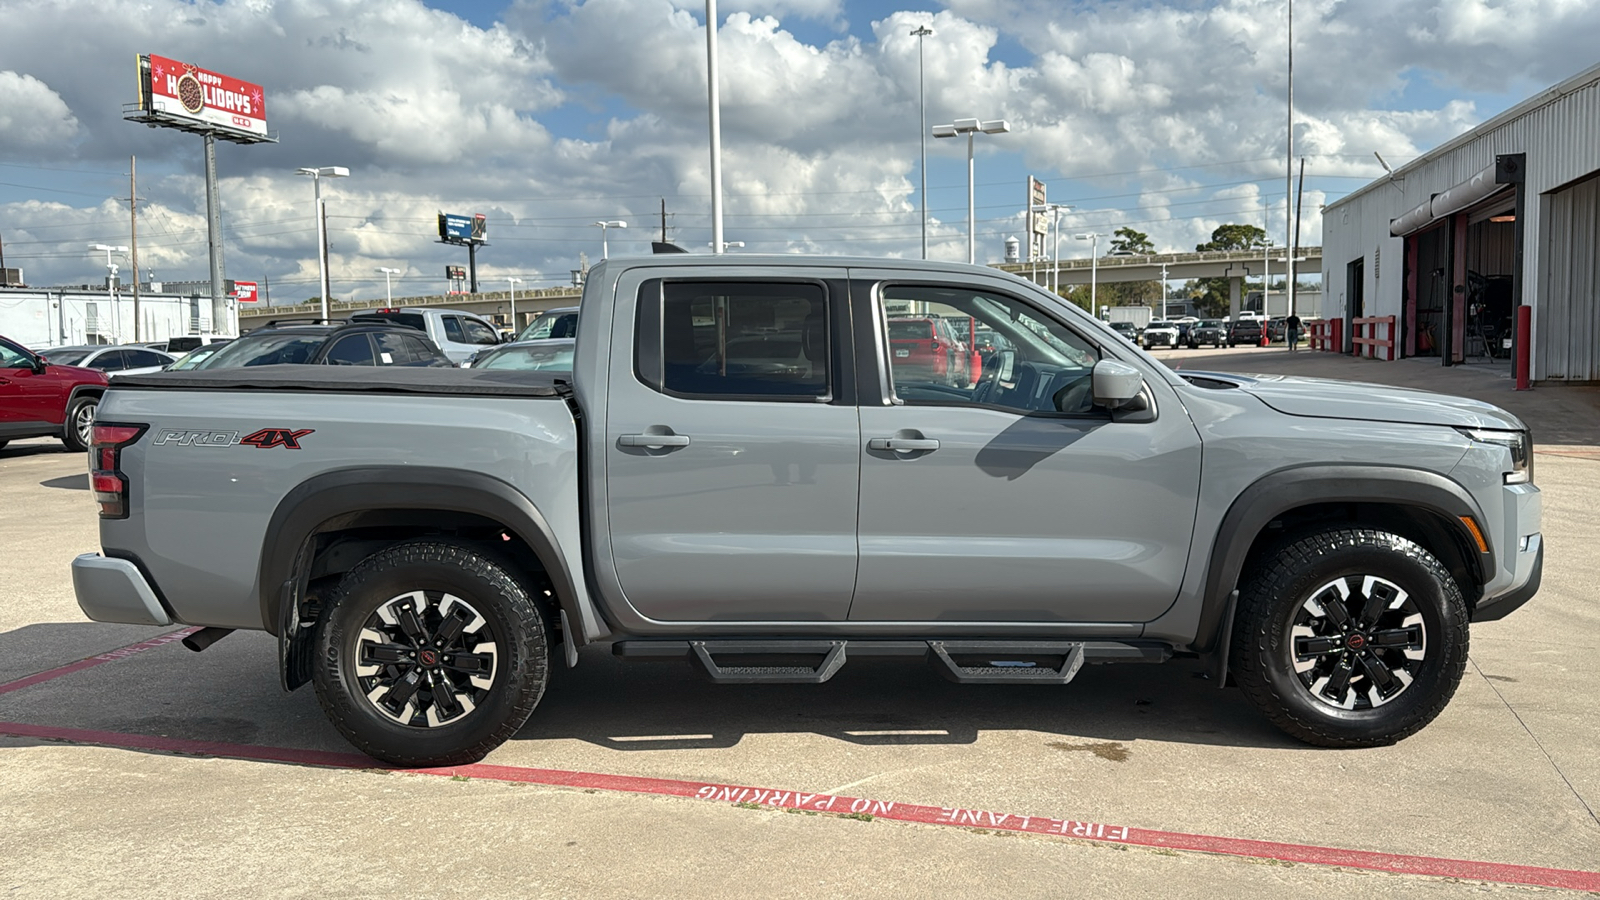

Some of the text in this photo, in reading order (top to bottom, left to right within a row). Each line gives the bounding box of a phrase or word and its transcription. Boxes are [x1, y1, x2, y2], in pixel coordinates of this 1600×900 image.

[198, 72, 222, 86] HAPPY
[695, 786, 1129, 840] FIRE LANE NO PARKING
